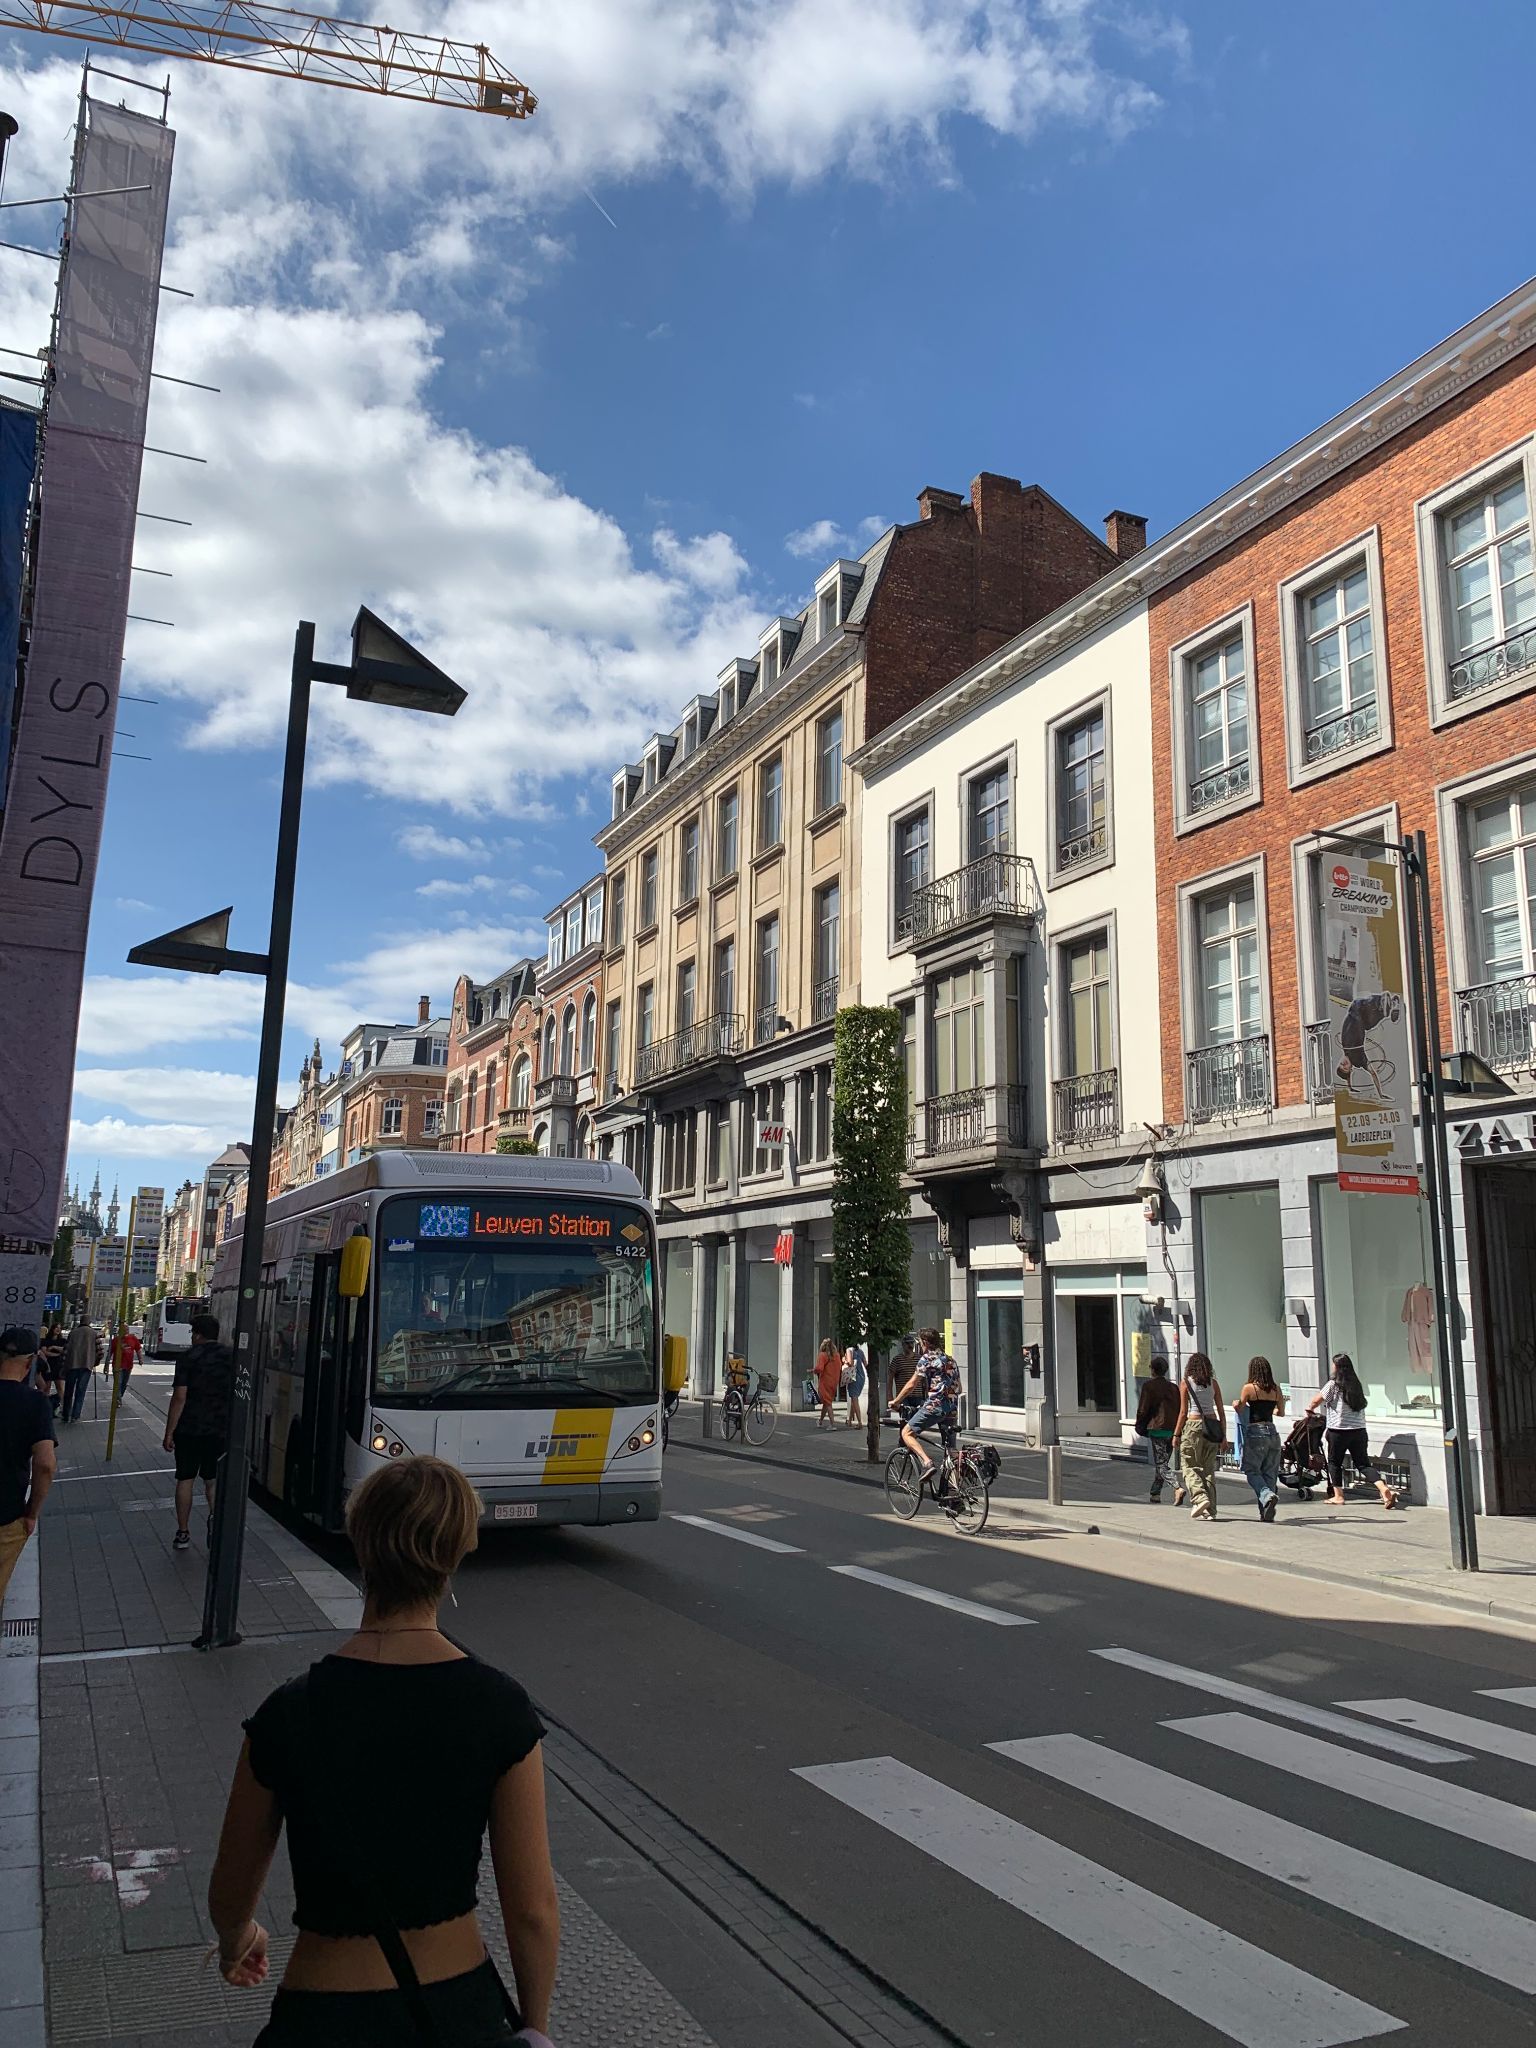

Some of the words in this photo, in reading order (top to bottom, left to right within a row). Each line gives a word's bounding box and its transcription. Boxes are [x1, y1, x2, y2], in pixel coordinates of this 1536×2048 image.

[20, 677, 109, 886] DYLS
[1360, 878, 1380, 890] WORLD
[1332, 887, 1388, 905] BREAKING
[1341, 903, 1378, 914] CHAMPIONSHIP
[1347, 1115, 1371, 1128] 22.09
[1379, 1111, 1400, 1124] 24.09
[760, 1126, 783, 1144] H&M
[1351, 1130, 1392, 1143] LADEUZEPLEIN
[475, 1211, 543, 1235] Leuven
[549, 1213, 611, 1237] Station
[616, 1246, 646, 1257] 5422
[525, 1441, 578, 1458] LIJN
